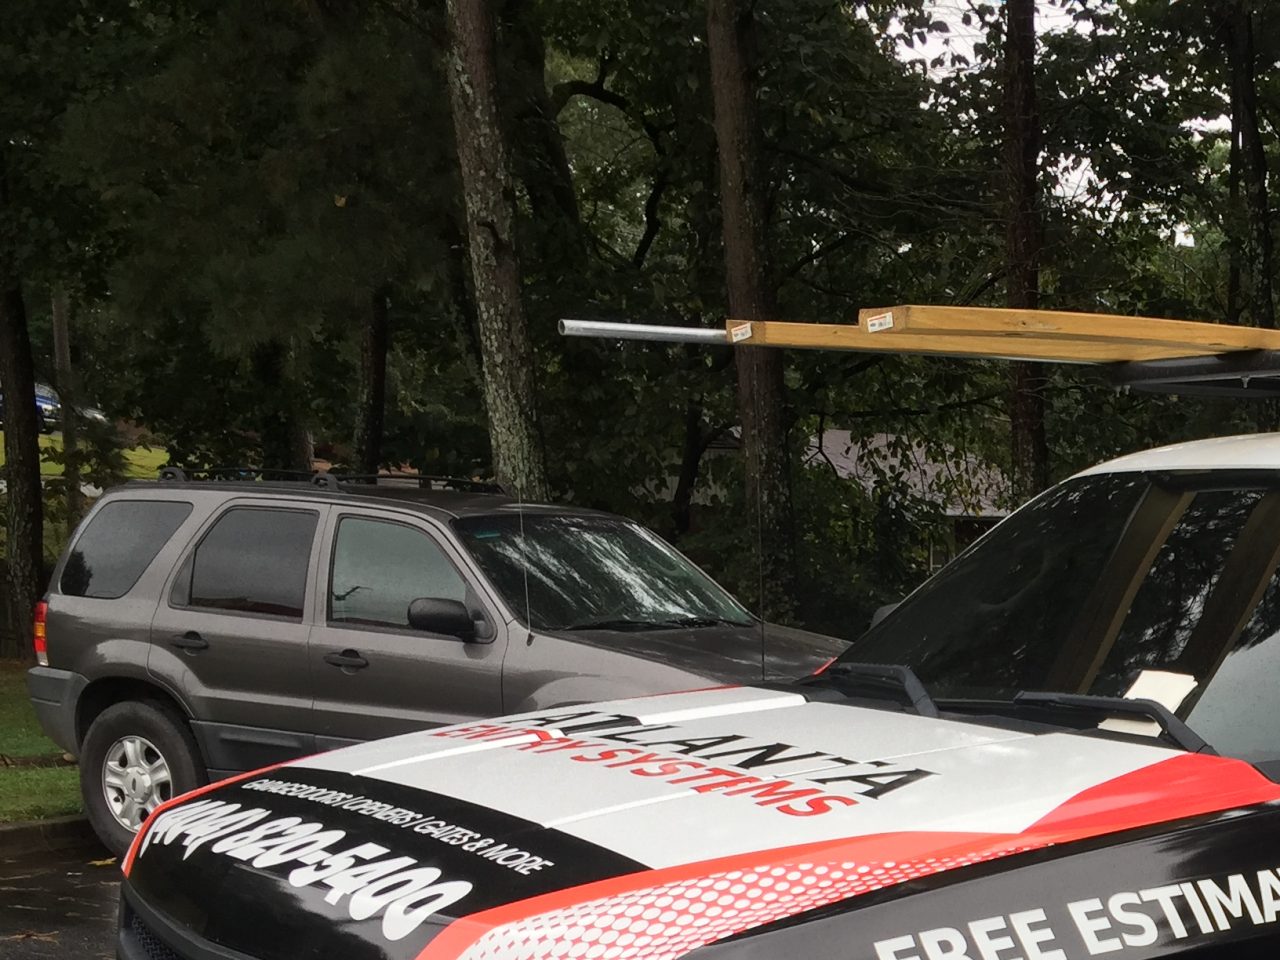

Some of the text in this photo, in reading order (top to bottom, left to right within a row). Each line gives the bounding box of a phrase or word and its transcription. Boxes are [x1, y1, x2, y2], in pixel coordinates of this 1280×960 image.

[432, 723, 861, 818] ENTRY SYSTEMS
[500, 710, 942, 801] ATLANTA
[211, 816, 474, 942] 820-5400
[413, 816, 479, 846] GATES
[476, 842, 556, 876] MORE
